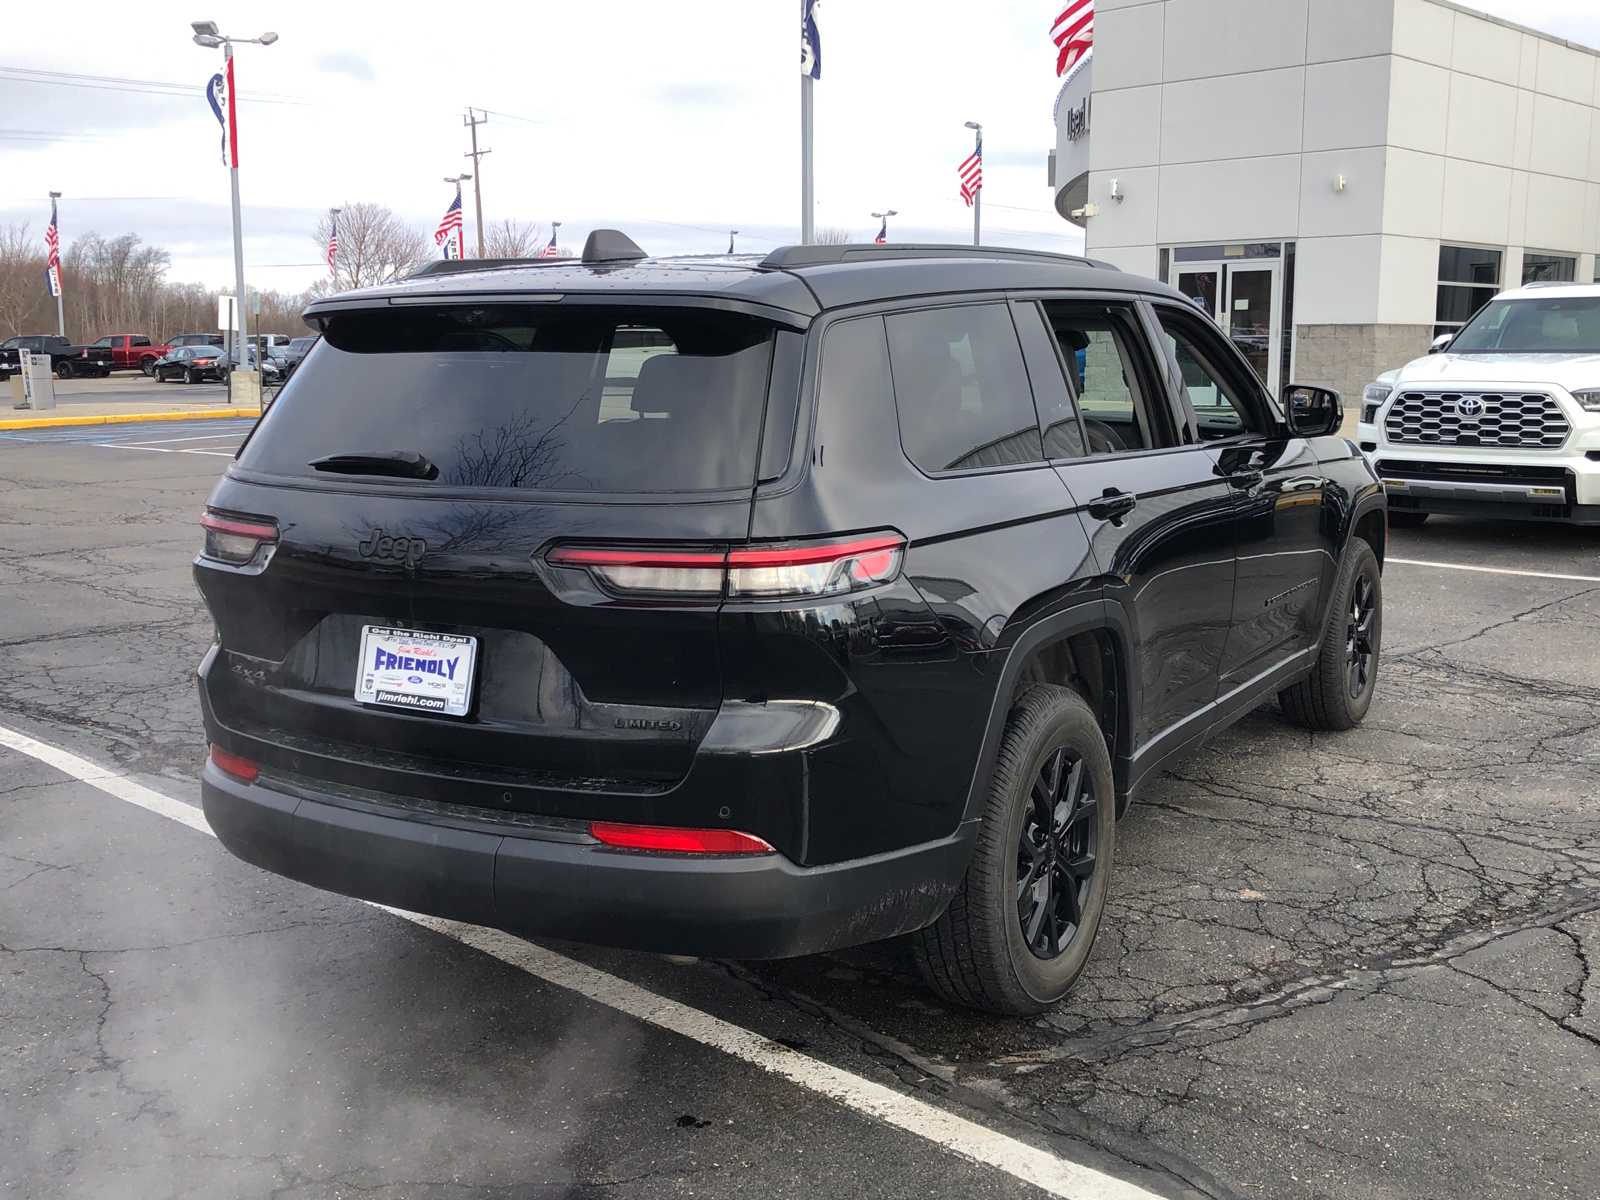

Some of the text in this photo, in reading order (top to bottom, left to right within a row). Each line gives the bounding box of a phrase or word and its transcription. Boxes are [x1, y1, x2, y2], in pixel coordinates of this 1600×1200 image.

[1067, 97, 1086, 141] Used
[359, 528, 428, 570] Jeep
[371, 627, 467, 644] Get the Riehl Deal
[396, 645, 437, 658] Jim Riehl's
[374, 646, 460, 681] FRIENDLY
[377, 691, 445, 709] jimriehl.com
[614, 718, 682, 732] LIMITED
